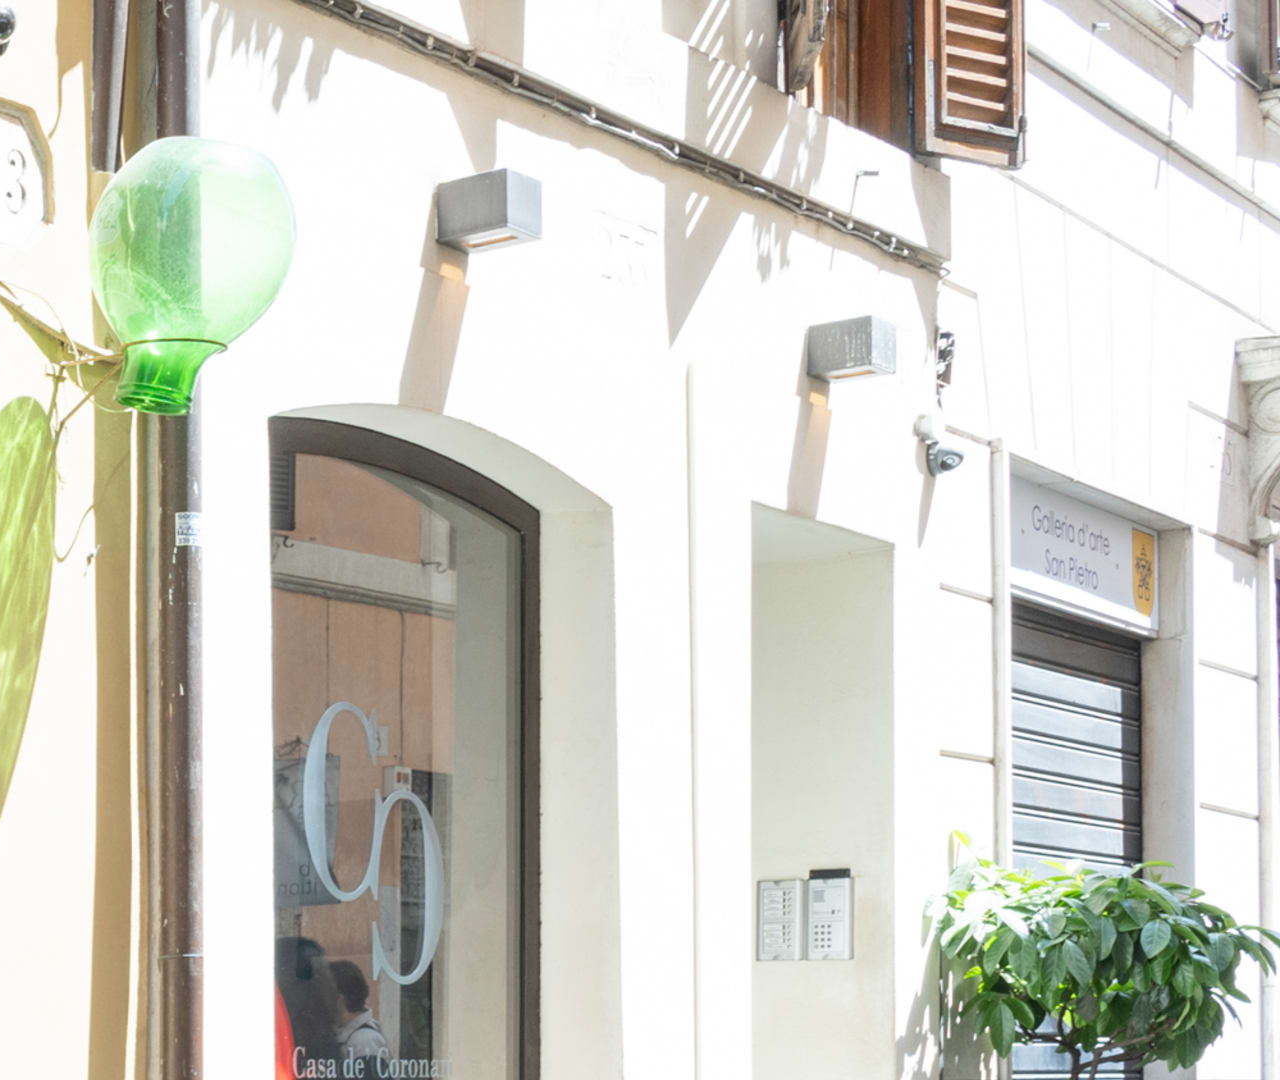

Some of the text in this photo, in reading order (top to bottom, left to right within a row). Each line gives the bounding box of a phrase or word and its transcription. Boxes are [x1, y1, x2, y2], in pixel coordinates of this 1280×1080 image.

[1031, 504, 1111, 557] Galleria d'arte
[1044, 548, 1099, 591] San Pietro
[292, 1046, 337, 1079] Casa
